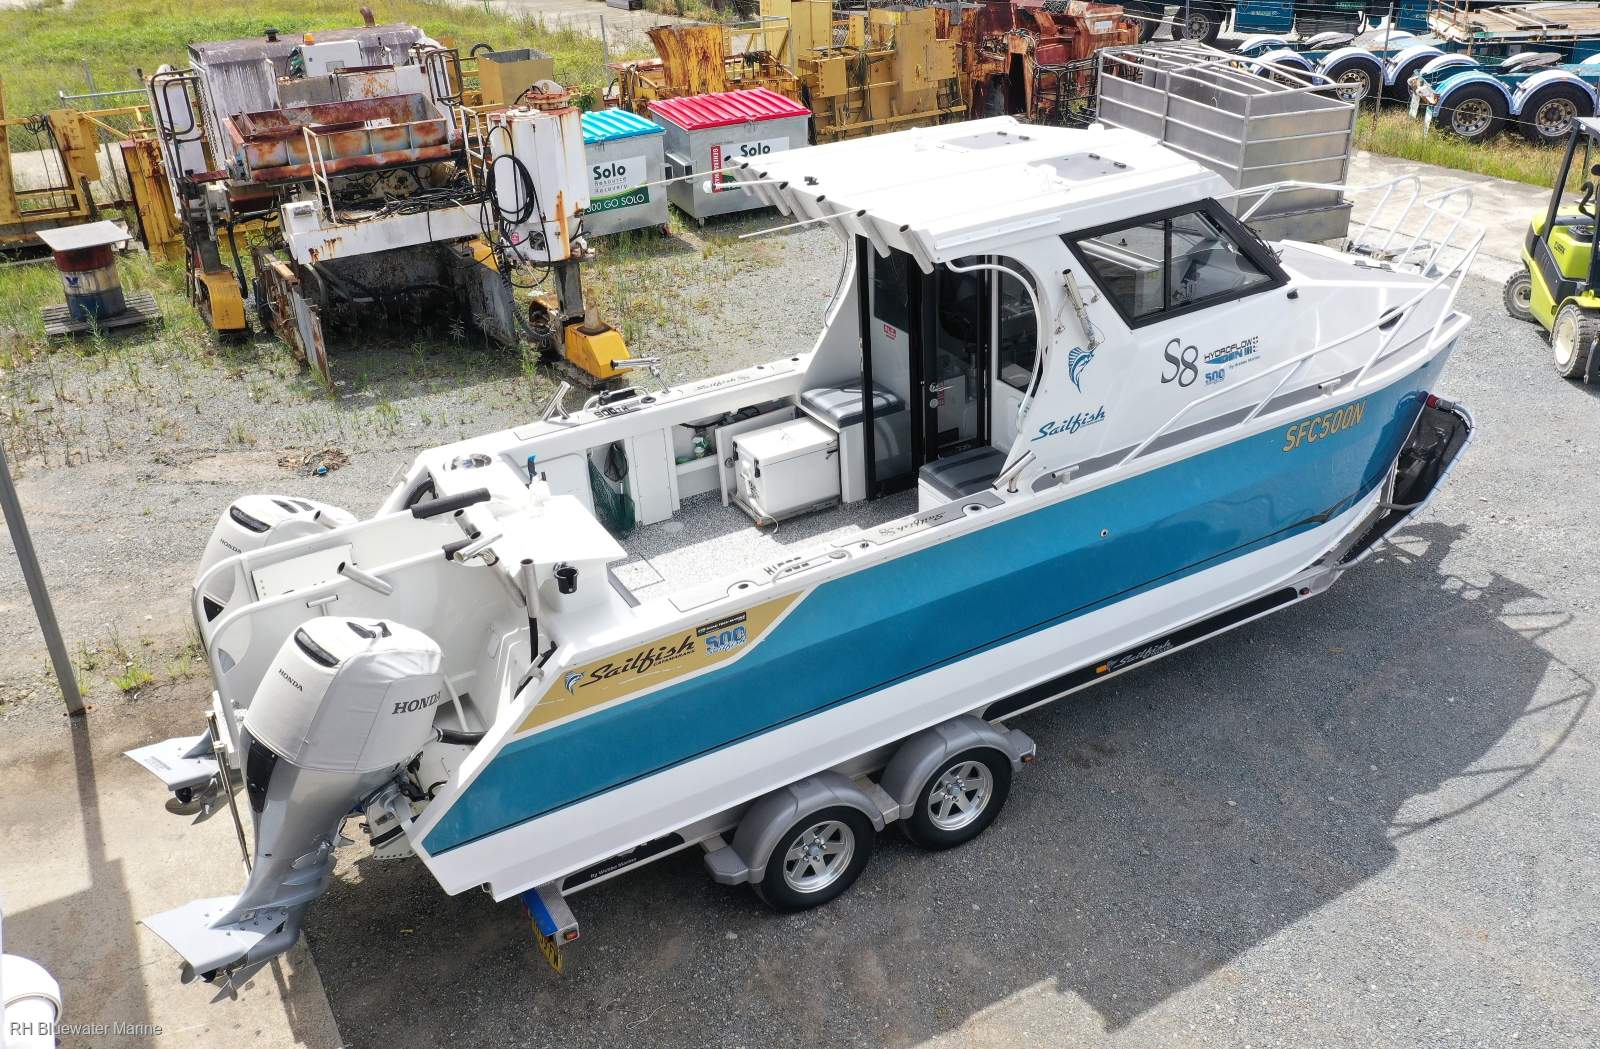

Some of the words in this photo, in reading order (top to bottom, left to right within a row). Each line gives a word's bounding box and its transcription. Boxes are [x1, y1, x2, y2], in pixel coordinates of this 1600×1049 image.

[740, 142, 771, 157] Solo
[592, 162, 626, 180] Solo
[604, 199, 619, 209] GO
[621, 193, 645, 206] SOLO
[1160, 337, 1199, 388] S8
[1030, 405, 1105, 442] Sailfish
[1282, 399, 1368, 453] SFC500N
[219, 537, 242, 554] HONDA
[578, 634, 695, 688] Sailfish
[278, 667, 304, 692] HONDA
